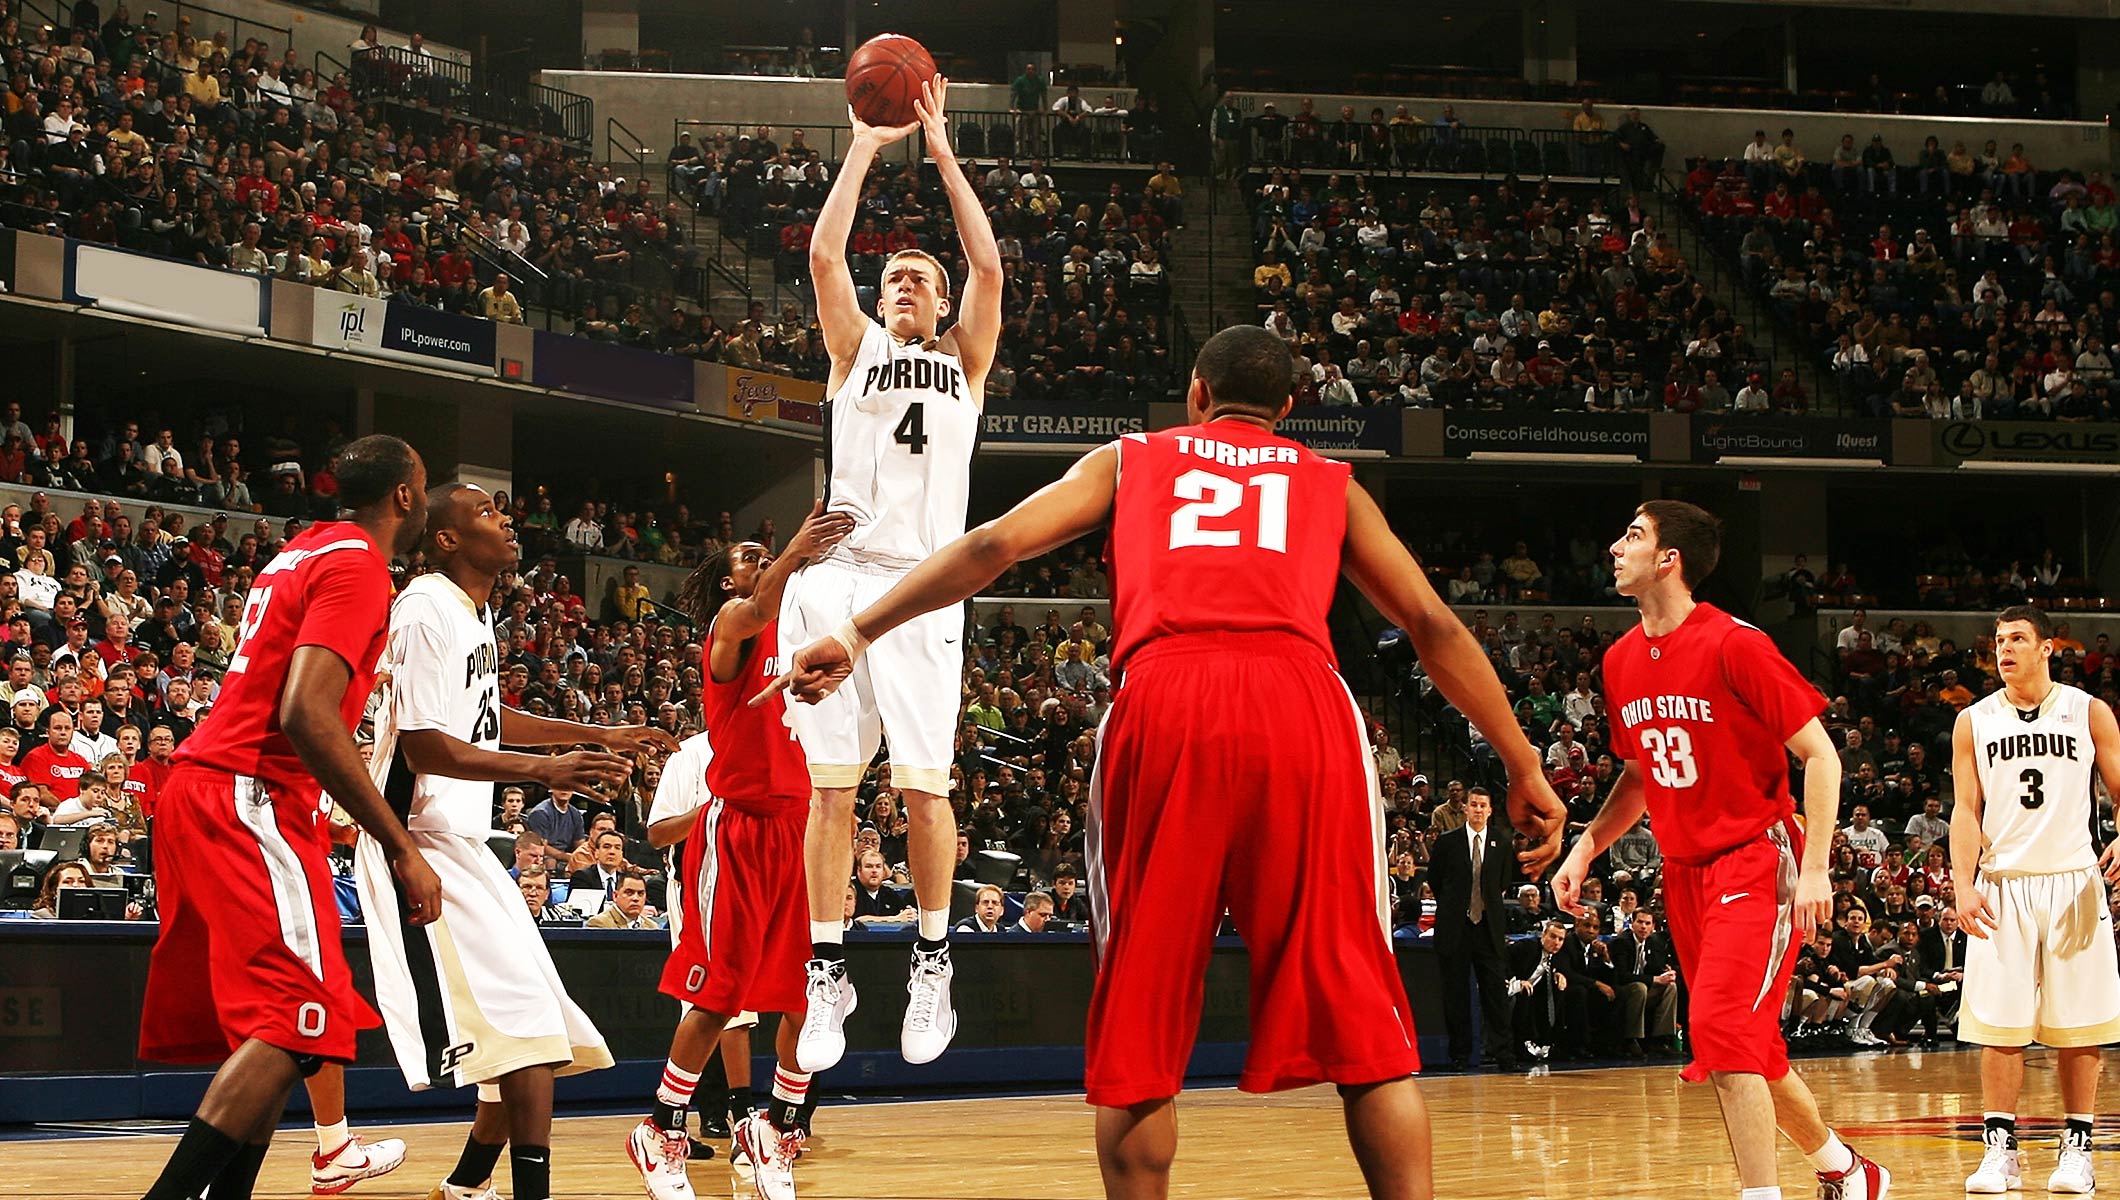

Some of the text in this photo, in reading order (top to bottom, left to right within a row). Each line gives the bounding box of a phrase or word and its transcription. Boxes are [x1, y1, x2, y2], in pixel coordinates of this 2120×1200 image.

[340, 308, 365, 341] ipl
[401, 328, 471, 352] IPLpower.com
[733, 375, 777, 404] Fever
[862, 358, 960, 401] PURDUE
[893, 402, 928, 454] 4
[982, 415, 1144, 435] RT GRAPHICS
[1274, 414, 1367, 437] ommunity
[1446, 425, 1648, 444] ConsecoFieldhouse.com
[1990, 431, 2119, 451] LEXUS
[1174, 435, 1299, 467] TURNER
[1306, 439, 1360, 450] Network
[1702, 434, 1804, 449] LightBound
[1169, 468, 1290, 554] 21
[470, 687, 498, 743] 25
[1621, 695, 1714, 729] OHIO STATE
[1640, 726, 1699, 789] 33
[1986, 732, 2079, 769] PURDUE
[2019, 768, 2044, 810] 3
[685, 964, 707, 993] O
[3, 996, 45, 1026] SE
[297, 1001, 327, 1037] O
[441, 1041, 476, 1076] P
